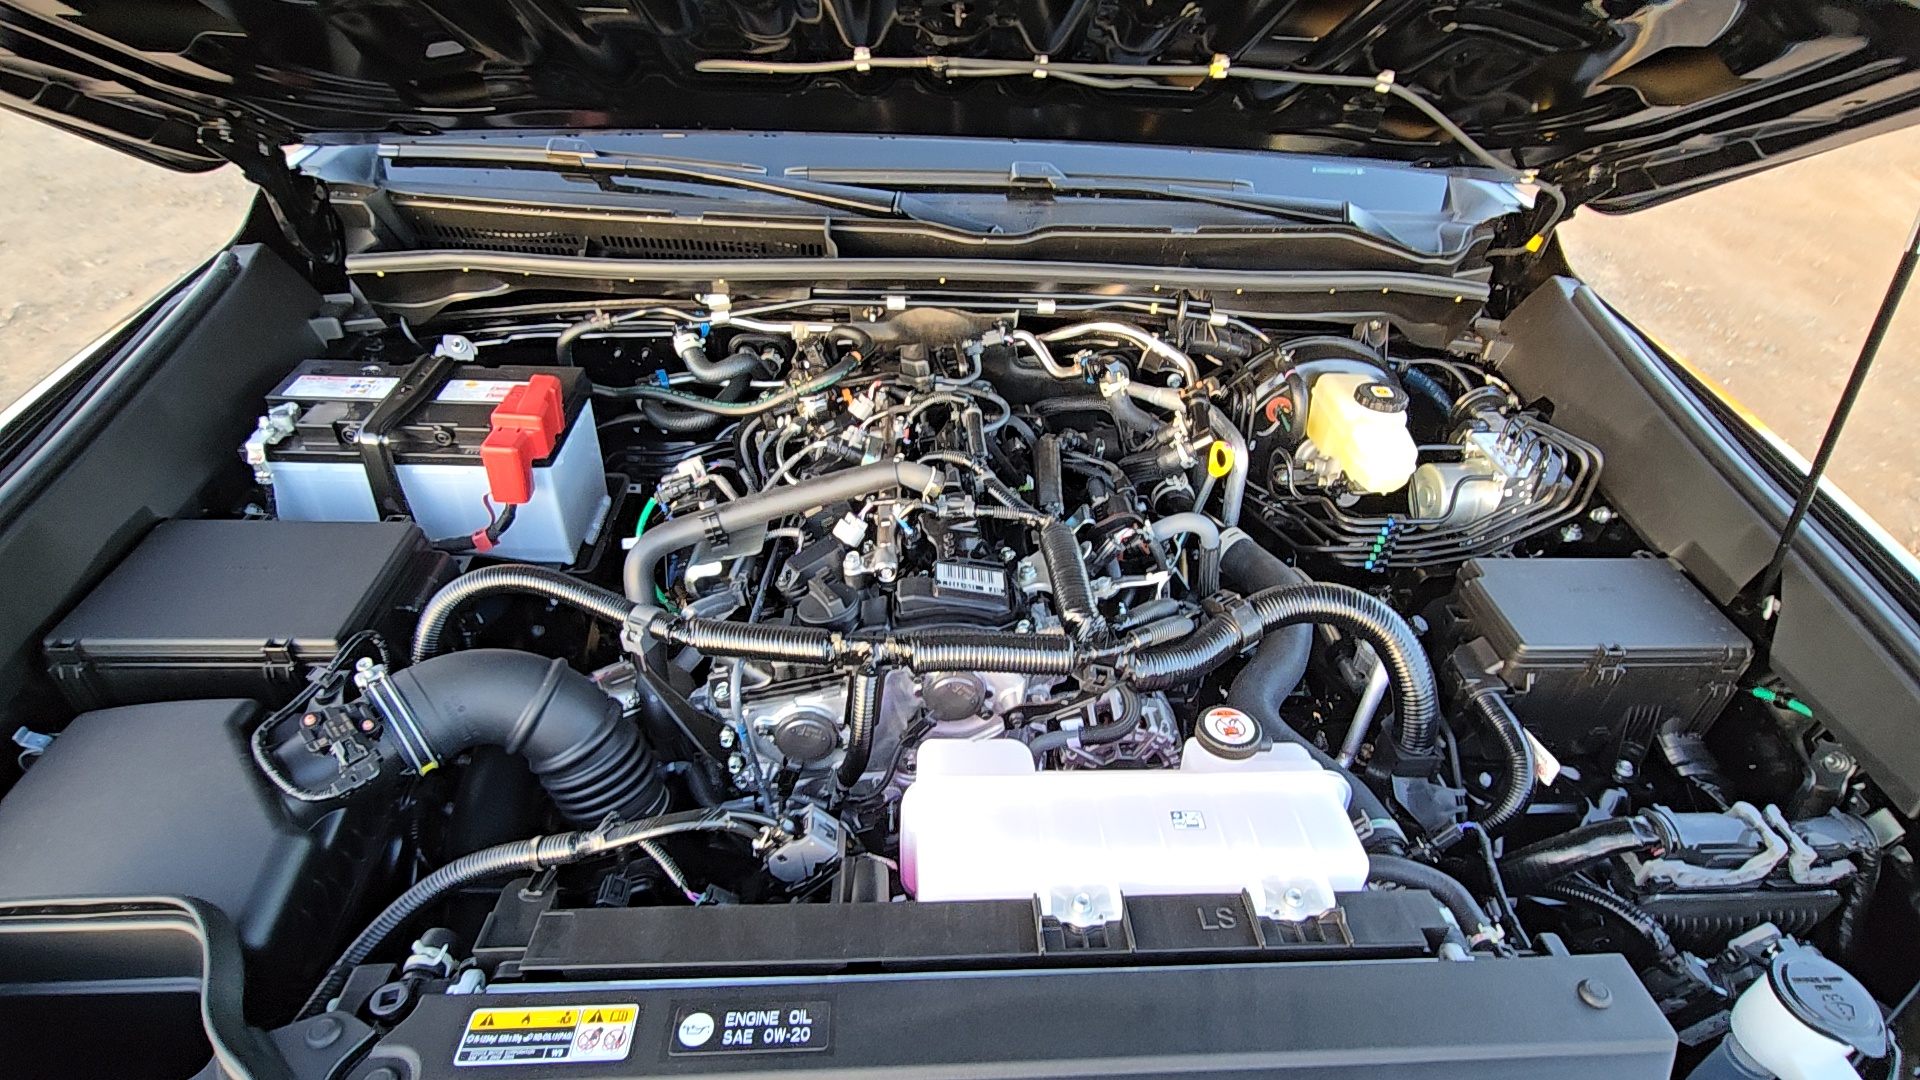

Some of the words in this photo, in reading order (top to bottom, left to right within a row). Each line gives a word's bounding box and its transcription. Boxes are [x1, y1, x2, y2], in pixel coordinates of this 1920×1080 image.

[1197, 906, 1237, 930] LS
[724, 1010, 780, 1028] ENGINE
[788, 1008, 813, 1025] OIL
[722, 1028, 755, 1045] SAE
[763, 1026, 811, 1044] 0W-20
